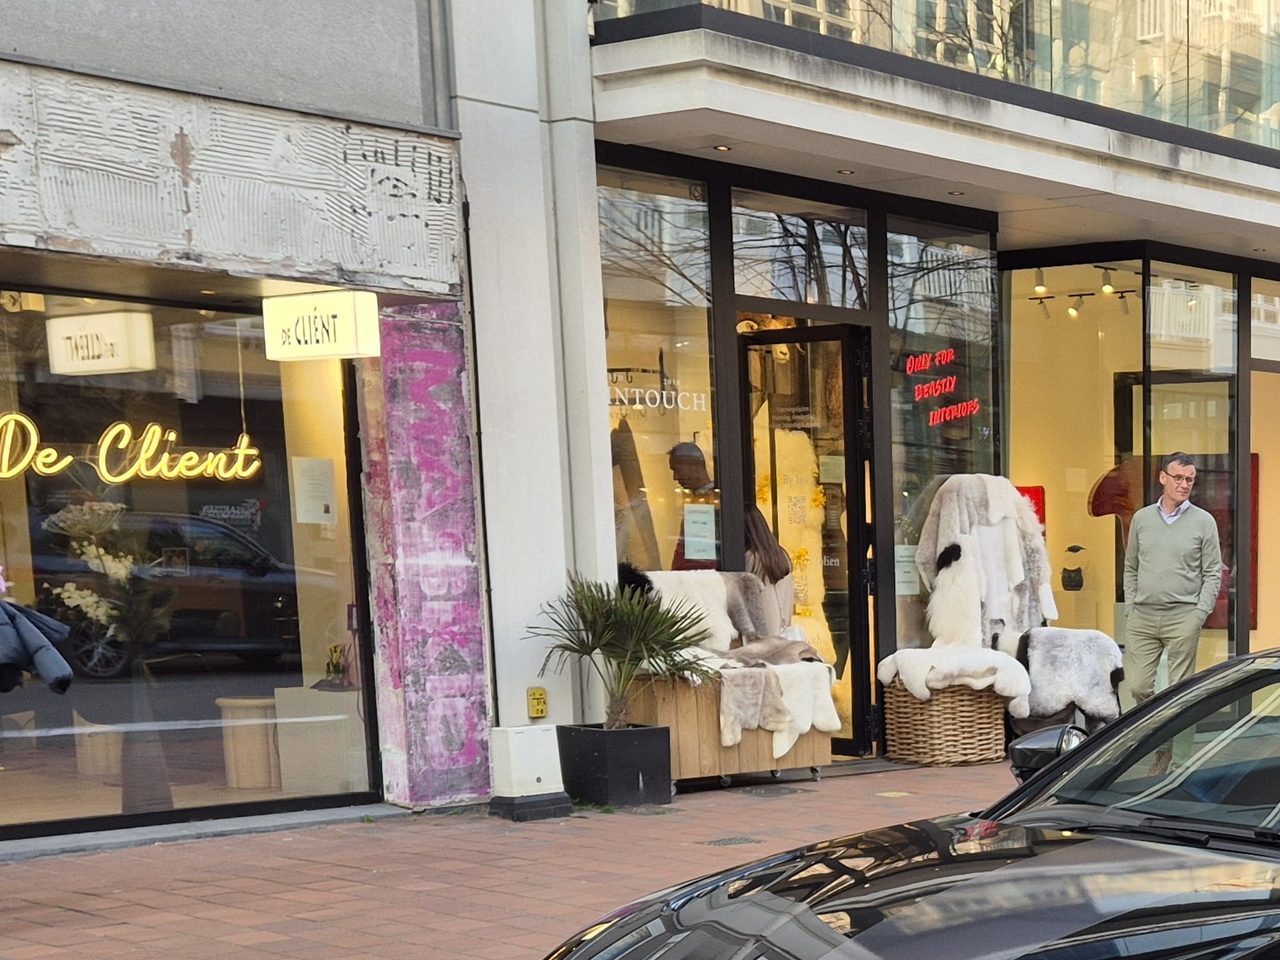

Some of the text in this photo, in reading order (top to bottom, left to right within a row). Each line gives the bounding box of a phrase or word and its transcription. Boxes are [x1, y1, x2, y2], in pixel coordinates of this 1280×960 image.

[282, 328, 291, 346] DE
[906, 348, 955, 375] ONLY FOR
[914, 375, 956, 401] BEASTLY
[928, 398, 980, 427] INTERIORS
[0, 412, 262, 484] De Client
